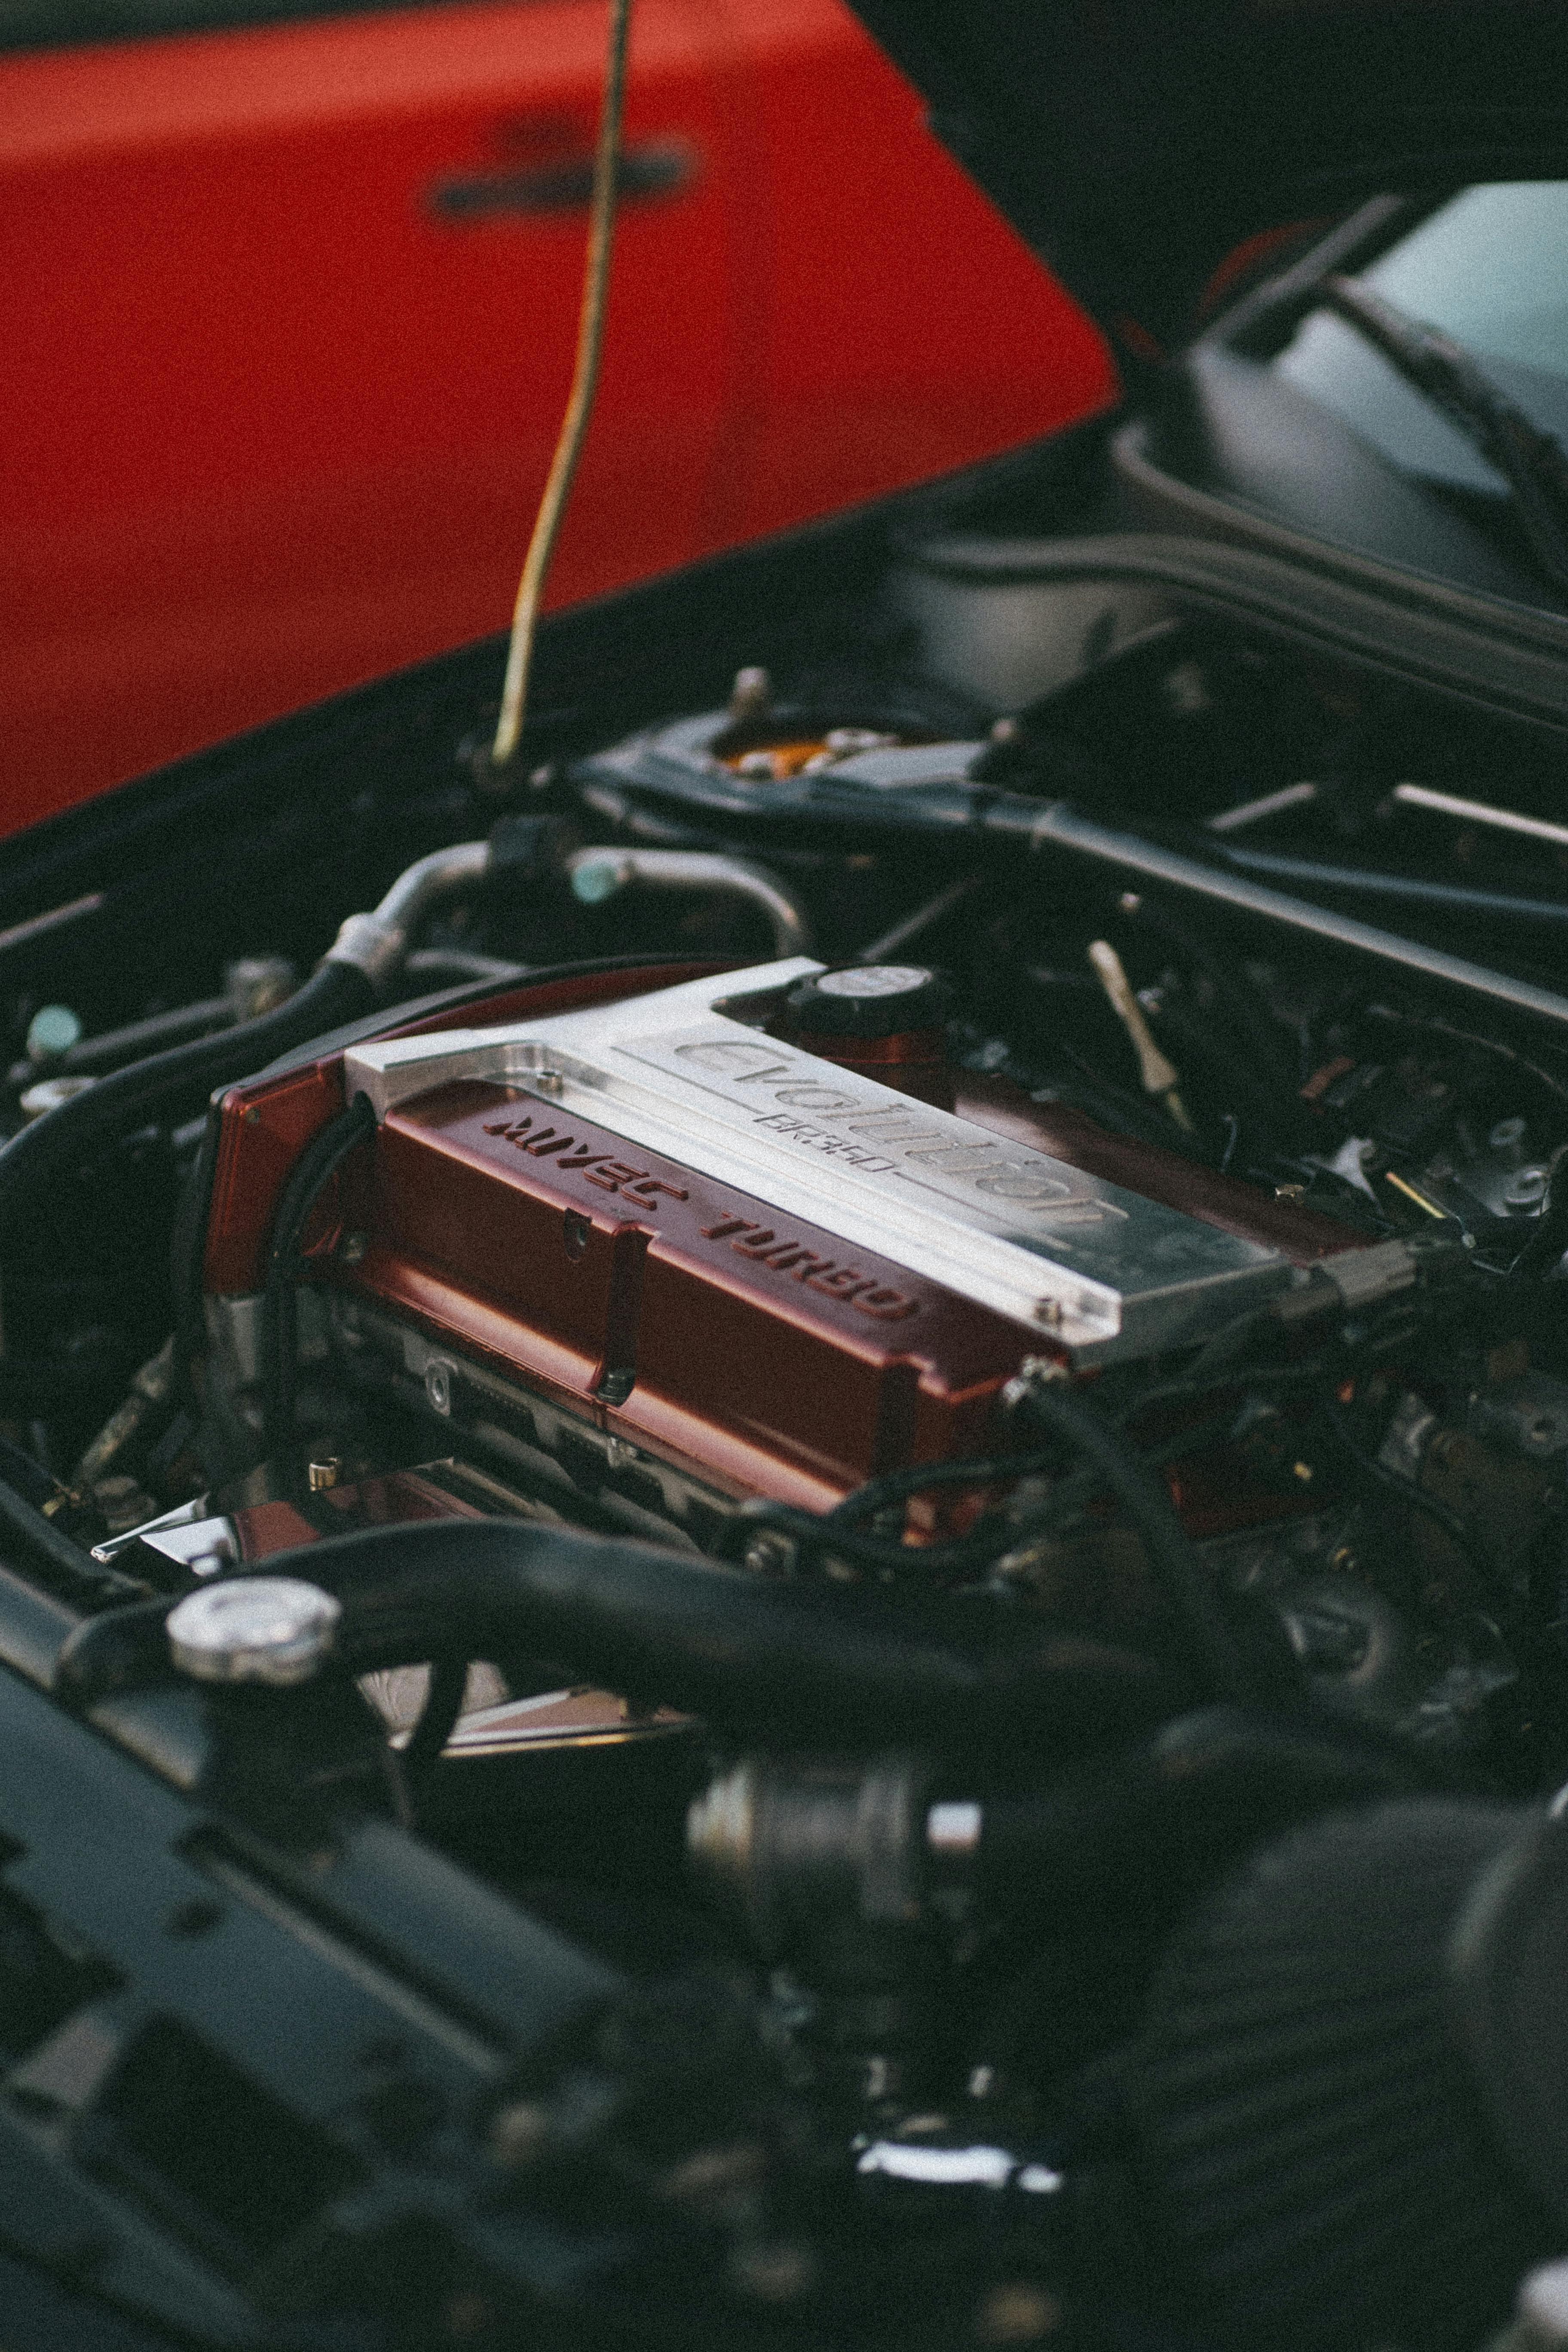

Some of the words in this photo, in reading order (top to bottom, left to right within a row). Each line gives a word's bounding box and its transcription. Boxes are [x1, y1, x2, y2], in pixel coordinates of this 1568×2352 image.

[482, 1117, 689, 1211] MIVEC
[699, 1211, 919, 1320] TURBO
[674, 1040, 1130, 1225] Evolution
